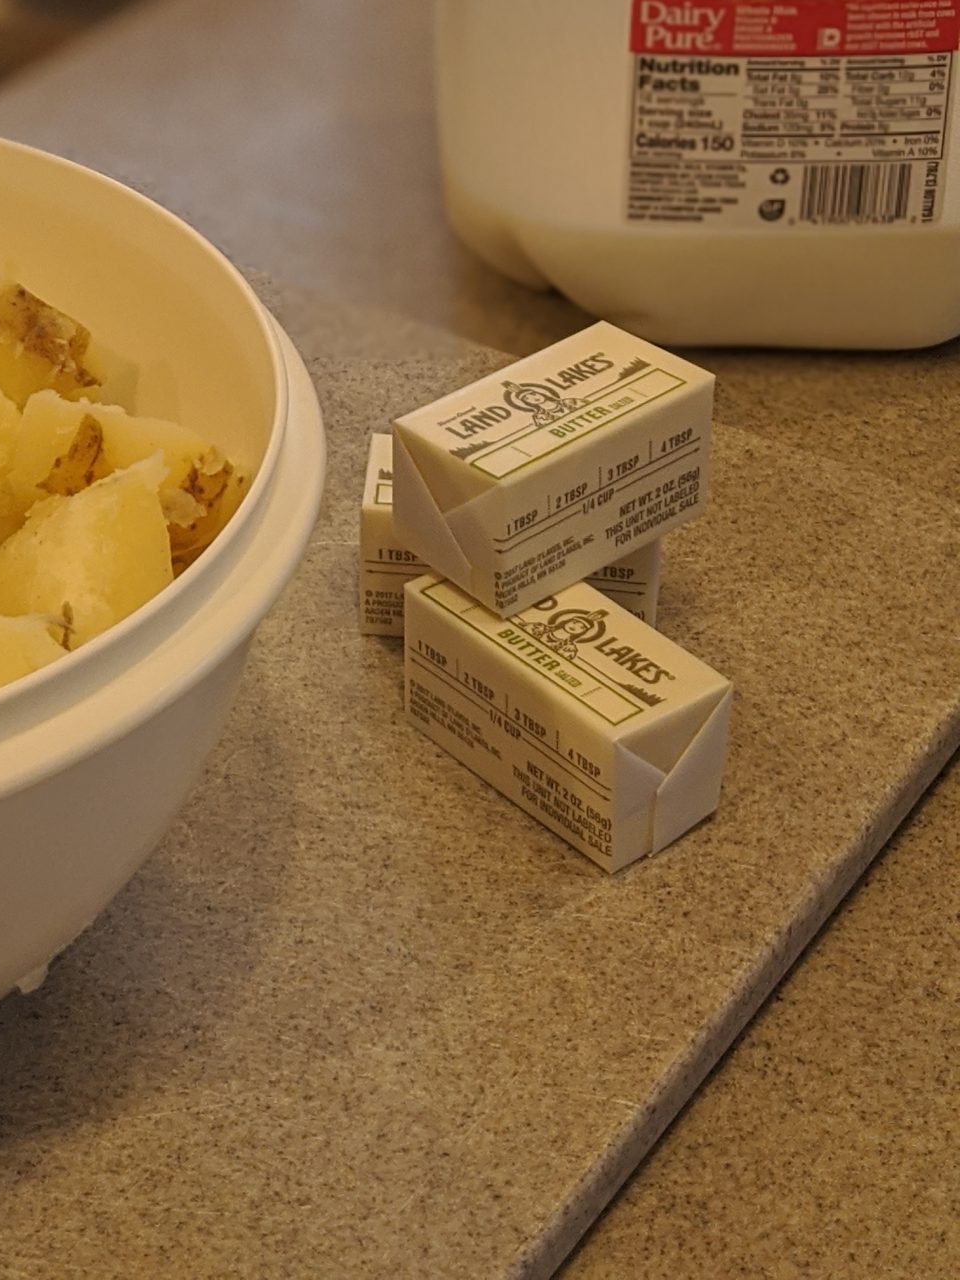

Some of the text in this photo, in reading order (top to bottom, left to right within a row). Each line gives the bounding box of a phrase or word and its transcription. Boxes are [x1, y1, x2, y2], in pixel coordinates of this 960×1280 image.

[640, 0, 726, 32] Dairy
[639, 57, 740, 76] Nutrition
[930, 69, 946, 78] 4%
[638, 74, 701, 92] Facts
[928, 82, 945, 92] 0%
[926, 107, 942, 116] 0%
[636, 131, 736, 152] Calories 150
[904, 136, 922, 145] Iron
[924, 135, 939, 145] 0%
[907, 148, 916, 157] A
[918, 146, 938, 156] 10%
[921, 189, 937, 218] GALLON
[444, 405, 512, 440] LAND
[544, 355, 615, 391] LAKES
[548, 406, 613, 439] BUTTER
[660, 427, 692, 452] 4 TBSP
[607, 453, 640, 481] 3 TBSP
[555, 482, 588, 510] 2 TBSP
[582, 487, 615, 515] 1/4 CUP
[605, 480, 699, 540] THIS UNIT NOT LABELED
[619, 499, 636, 518] NET
[655, 487, 662, 499] 2
[507, 509, 538, 536] 1 TBSP
[615, 530, 632, 547] FOR
[679, 492, 699, 513] SALE
[378, 549, 383, 560] 1
[603, 566, 635, 580] TBSP
[424, 643, 448, 667] TBSP
[497, 628, 561, 672] BUTTER
[593, 636, 671, 685] LAKES
[464, 671, 495, 701] 2 TBSP
[489, 708, 521, 740] 1/4 CUP
[514, 707, 547, 738] 3 TBSP
[568, 747, 601, 778] 4 TBSP
[526, 759, 545, 781] NET
[546, 774, 560, 795] WT.
[562, 787, 569, 800] 2
[512, 763, 612, 844] THIS UNIT NOT LABELED
[521, 784, 613, 858] FOR INDIVIDUAL SALE
